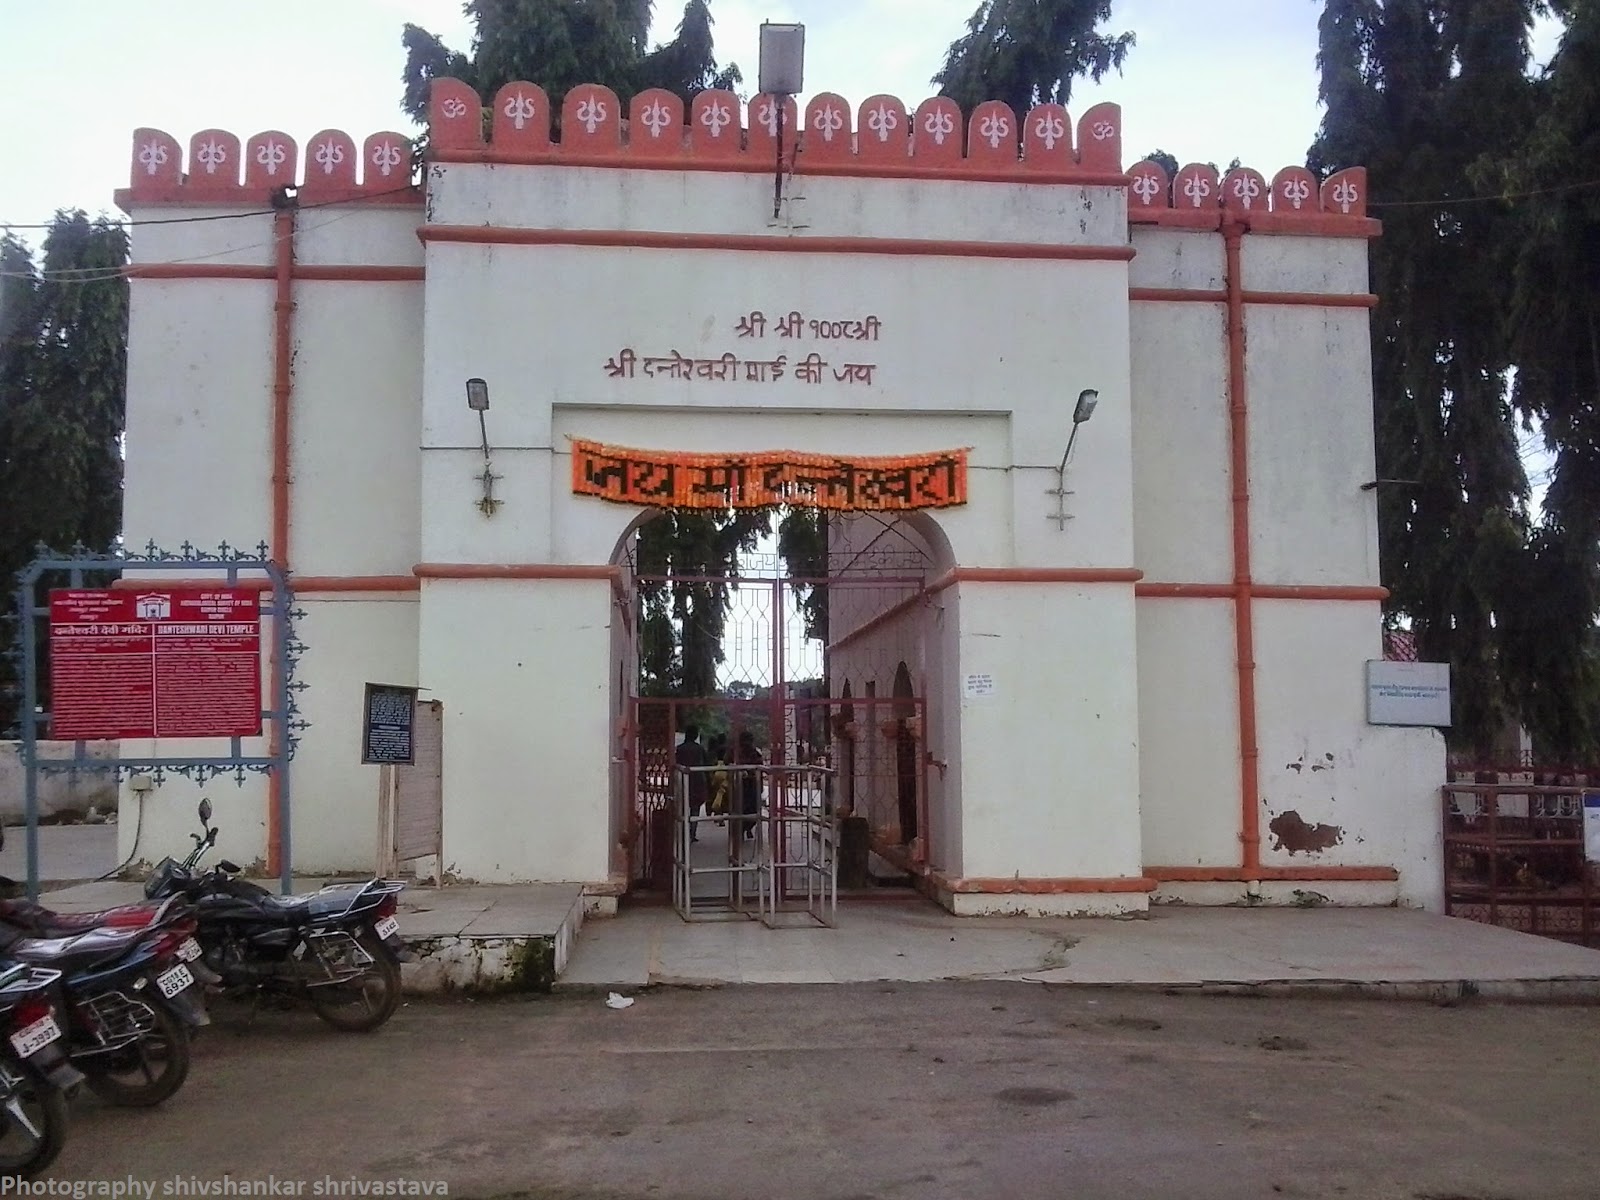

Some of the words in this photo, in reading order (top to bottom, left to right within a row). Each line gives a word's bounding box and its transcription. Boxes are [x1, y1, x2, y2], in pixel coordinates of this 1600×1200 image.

[735, 311, 767, 338] श्री
[774, 311, 805, 339] श्री
[604, 348, 637, 379] श्री
[795, 353, 828, 384] की
[833, 363, 877, 386] जय
[208, 624, 226, 635] DEVI
[226, 624, 255, 635] TEMPLE
[165, 974, 190, 995] 6937
